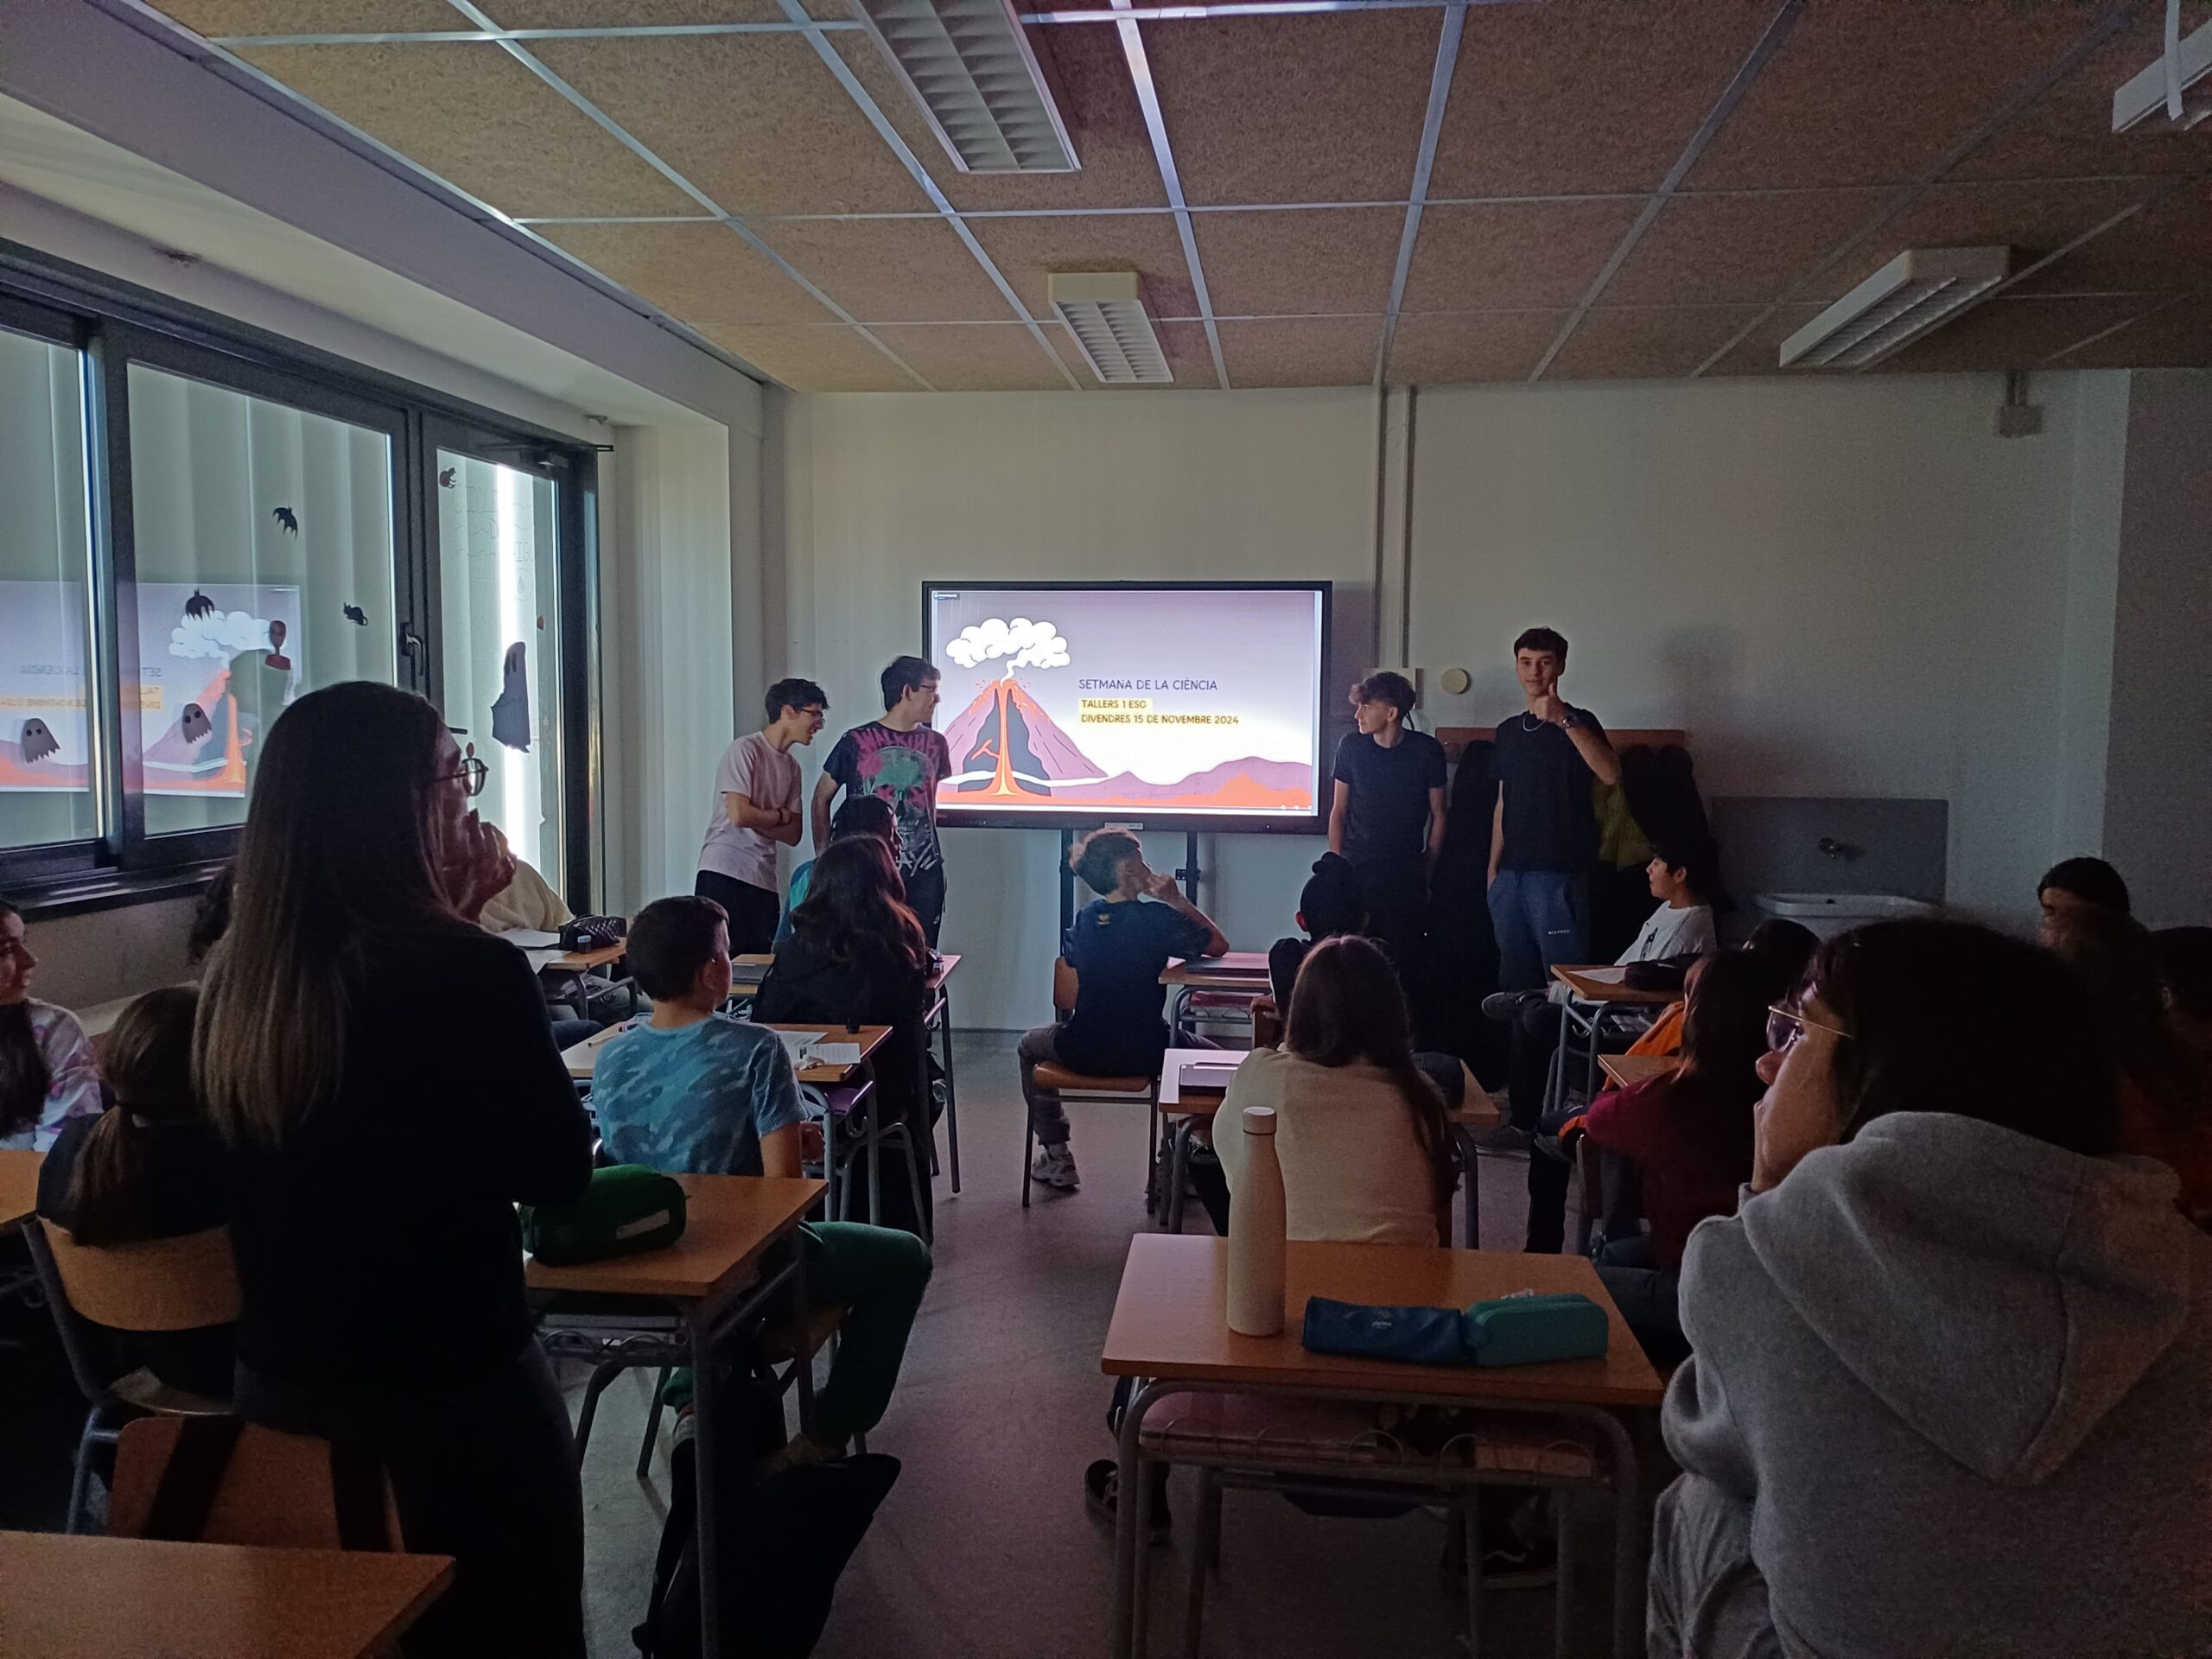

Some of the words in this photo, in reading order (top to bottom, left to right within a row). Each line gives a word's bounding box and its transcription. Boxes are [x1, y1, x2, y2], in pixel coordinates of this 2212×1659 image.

[1078, 678, 1133, 690] SETMANA
[1136, 679, 1152, 690] DE
[1154, 679, 1169, 690] LA
[1173, 677, 1218, 690] CIÈNCIA
[1081, 699, 1120, 709] TALLERS
[1128, 700, 1147, 709] ESO
[1081, 714, 1132, 723] DIVENDRES
[1134, 715, 1144, 723] 15
[1147, 715, 1159, 724] DE
[1161, 715, 1211, 724] NOVEMBRE
[1214, 715, 1239, 725] 2024
